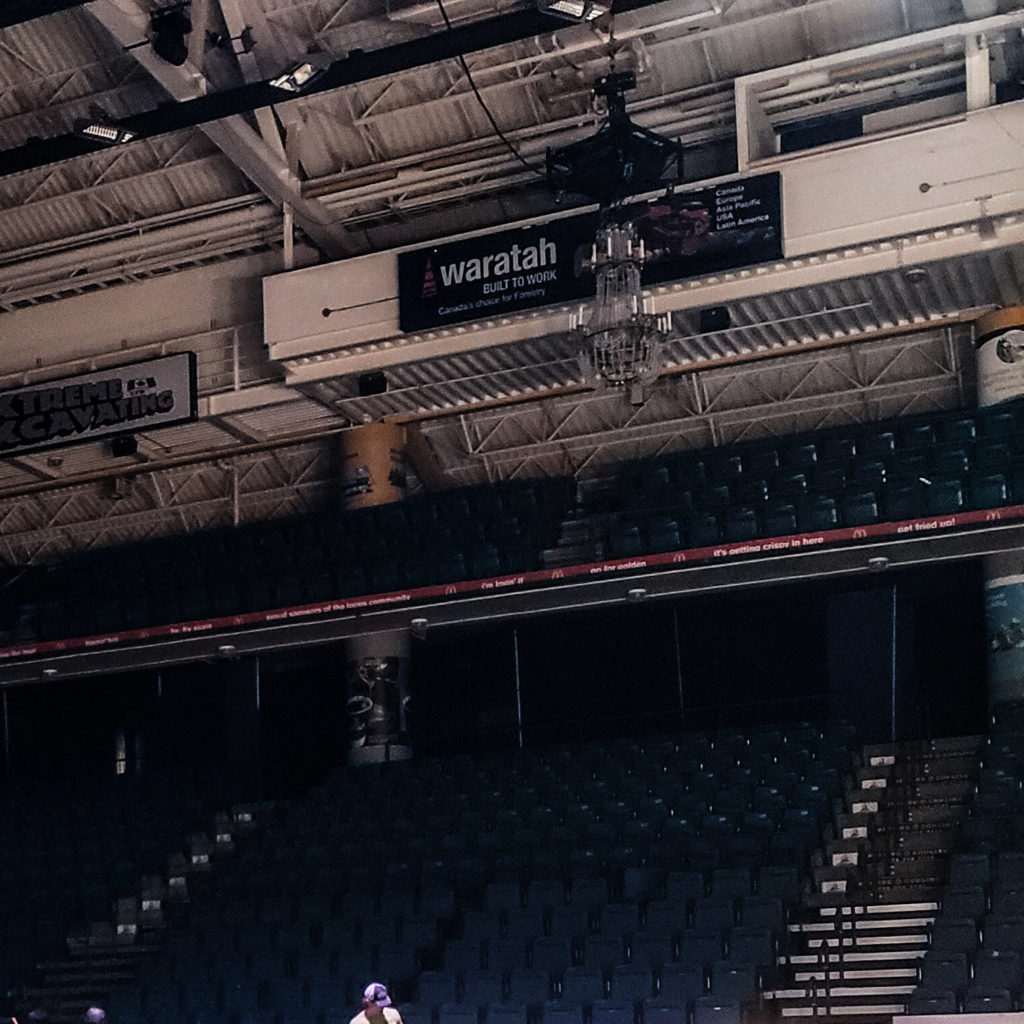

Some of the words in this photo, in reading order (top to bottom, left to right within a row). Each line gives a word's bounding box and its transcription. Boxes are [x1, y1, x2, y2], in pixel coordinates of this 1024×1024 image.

[715, 185, 745, 196] Canada
[716, 205, 734, 213] Asia
[735, 198, 761, 209] Pacific
[716, 212, 734, 221] USA
[716, 221, 736, 230] Latin
[737, 214, 769, 225] America
[440, 237, 558, 287] waratah
[483, 279, 510, 294] BUILT
[511, 276, 525, 288] TO
[526, 270, 558, 285] WORK
[475, 297, 501, 308] choice
[502, 293, 512, 304] for
[514, 288, 546, 300] Forestry
[915, 521, 937, 531] fried
[713, 549, 727, 558] it's
[729, 545, 761, 555] getting
[791, 539, 801, 547] in
[802, 537, 824, 545] here
[368, 594, 411, 605] community
